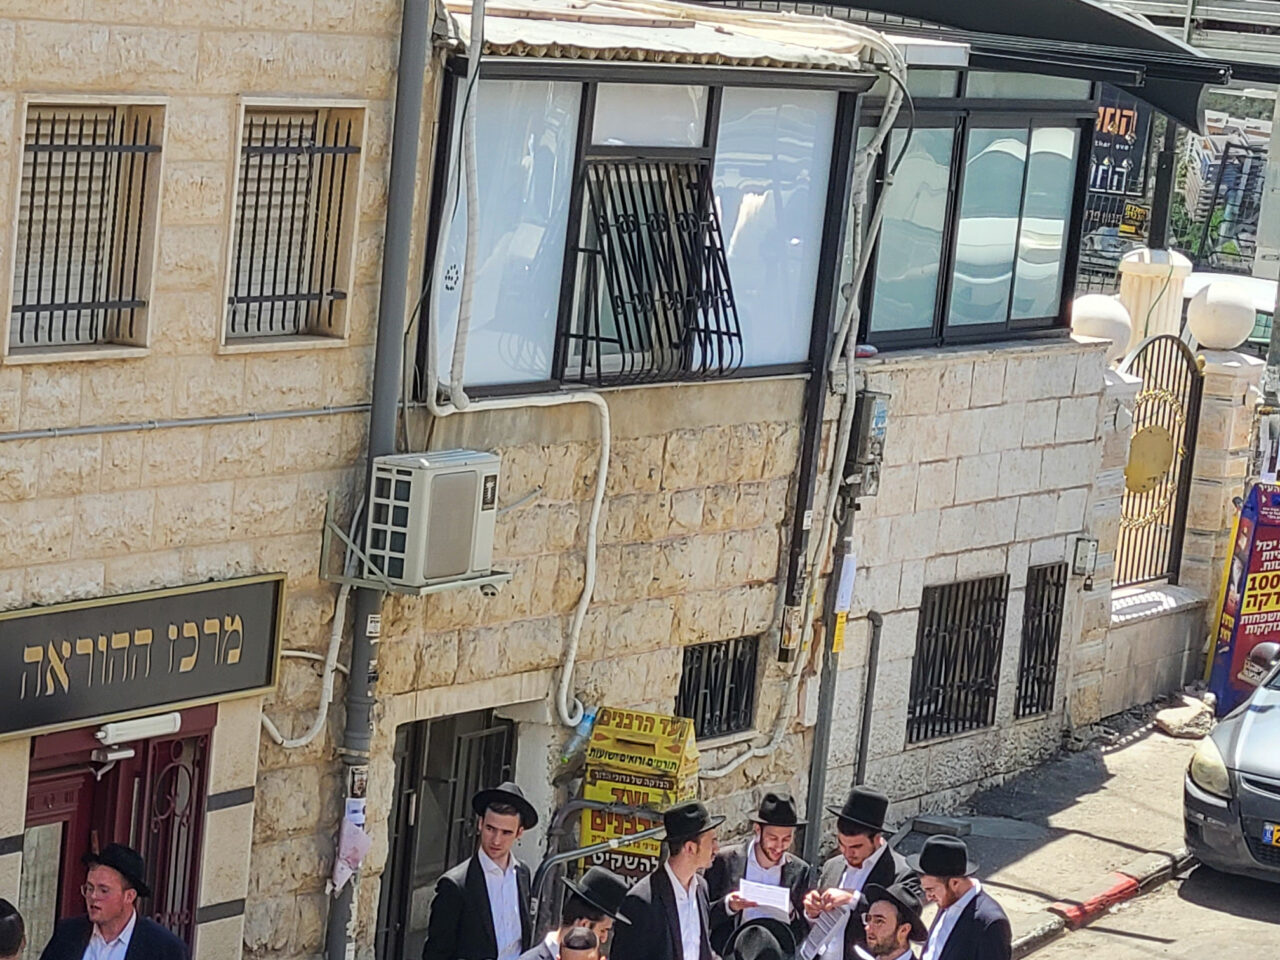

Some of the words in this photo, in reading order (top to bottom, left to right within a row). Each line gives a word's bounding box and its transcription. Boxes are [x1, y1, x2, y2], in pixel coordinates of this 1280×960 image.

[1256, 539, 1277, 552] יכול
[168, 614, 244, 674] מרכז
[20, 628, 154, 700] ההוראה
[598, 709, 656, 733] הרבנים
[631, 774, 643, 785] של
[592, 852, 659, 873] להשקיט
